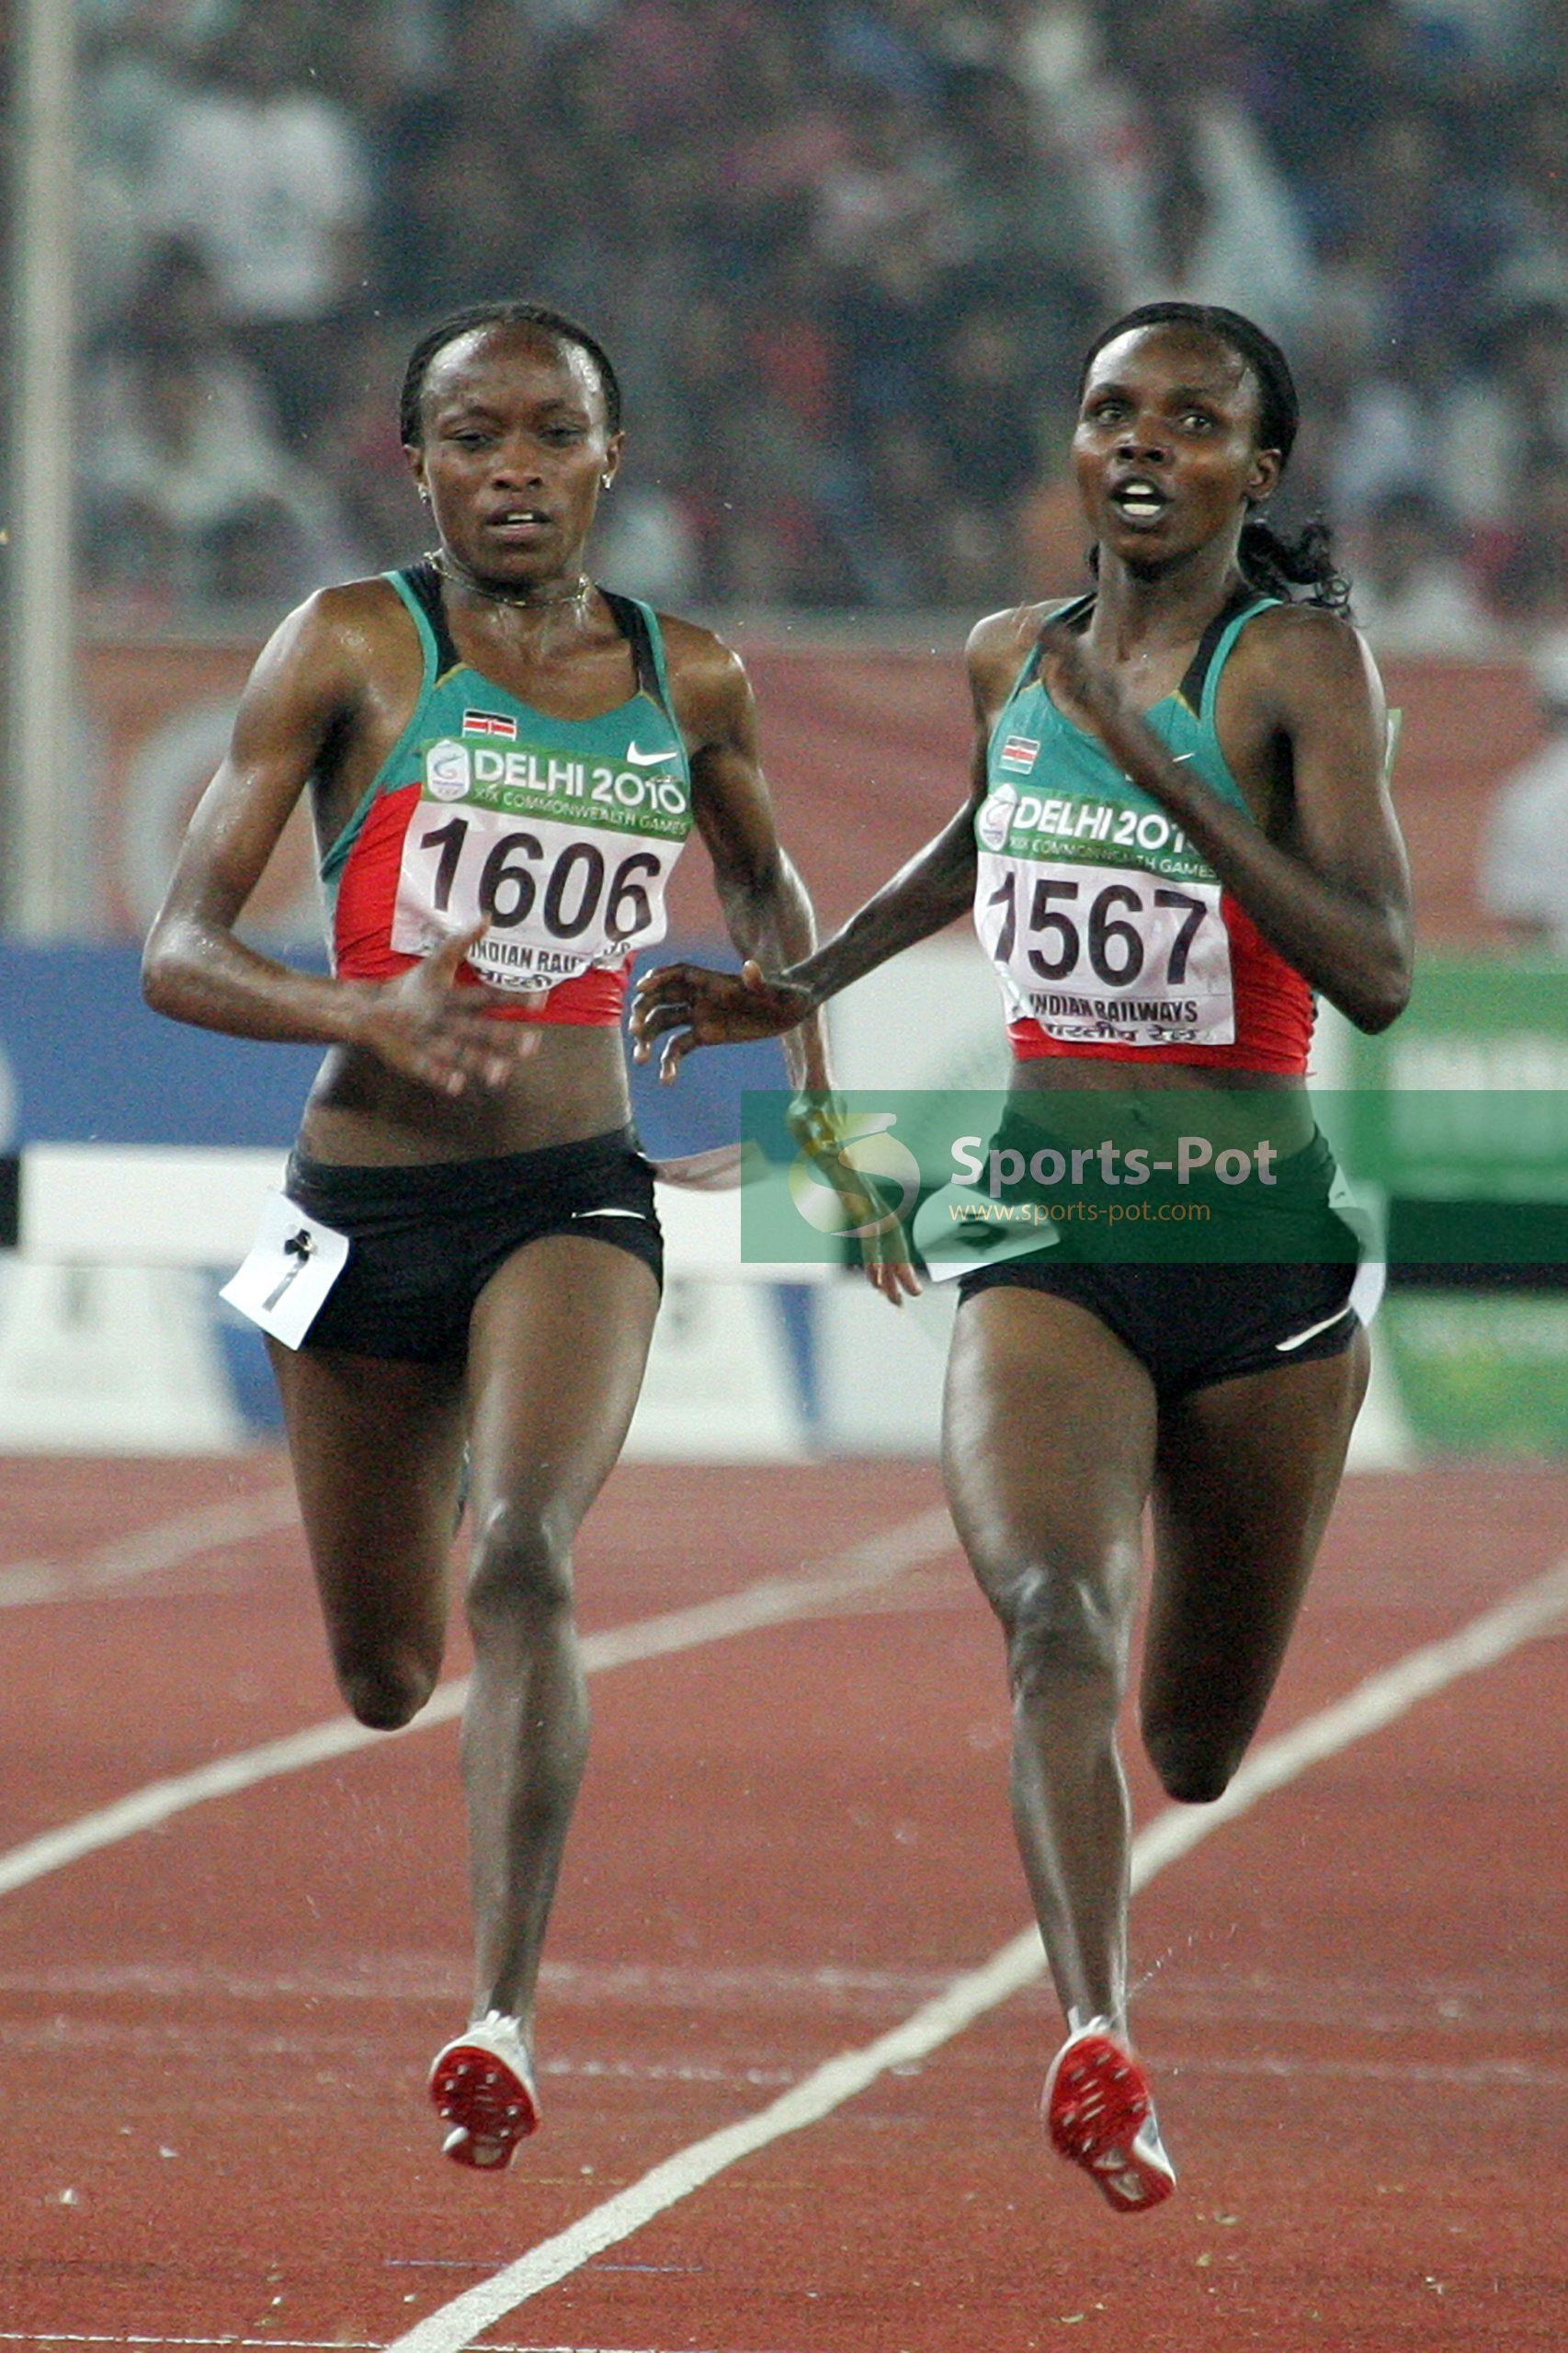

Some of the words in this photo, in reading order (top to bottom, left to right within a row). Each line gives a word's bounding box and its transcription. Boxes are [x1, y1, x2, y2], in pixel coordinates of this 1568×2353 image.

[473, 749, 585, 798] DELHI
[591, 769, 687, 814] 2010
[503, 791, 636, 827] COMMONWEALTH
[639, 813, 687, 835] GAMES
[1013, 796, 1113, 841] DELHI
[1113, 809, 1200, 854] 201
[420, 817, 662, 940] 1606
[471, 939, 533, 969] INDIAN
[986, 870, 1209, 987] 1567
[1029, 993, 1093, 1017] INDIAN
[1095, 1000, 1199, 1023] RAILWAYS
